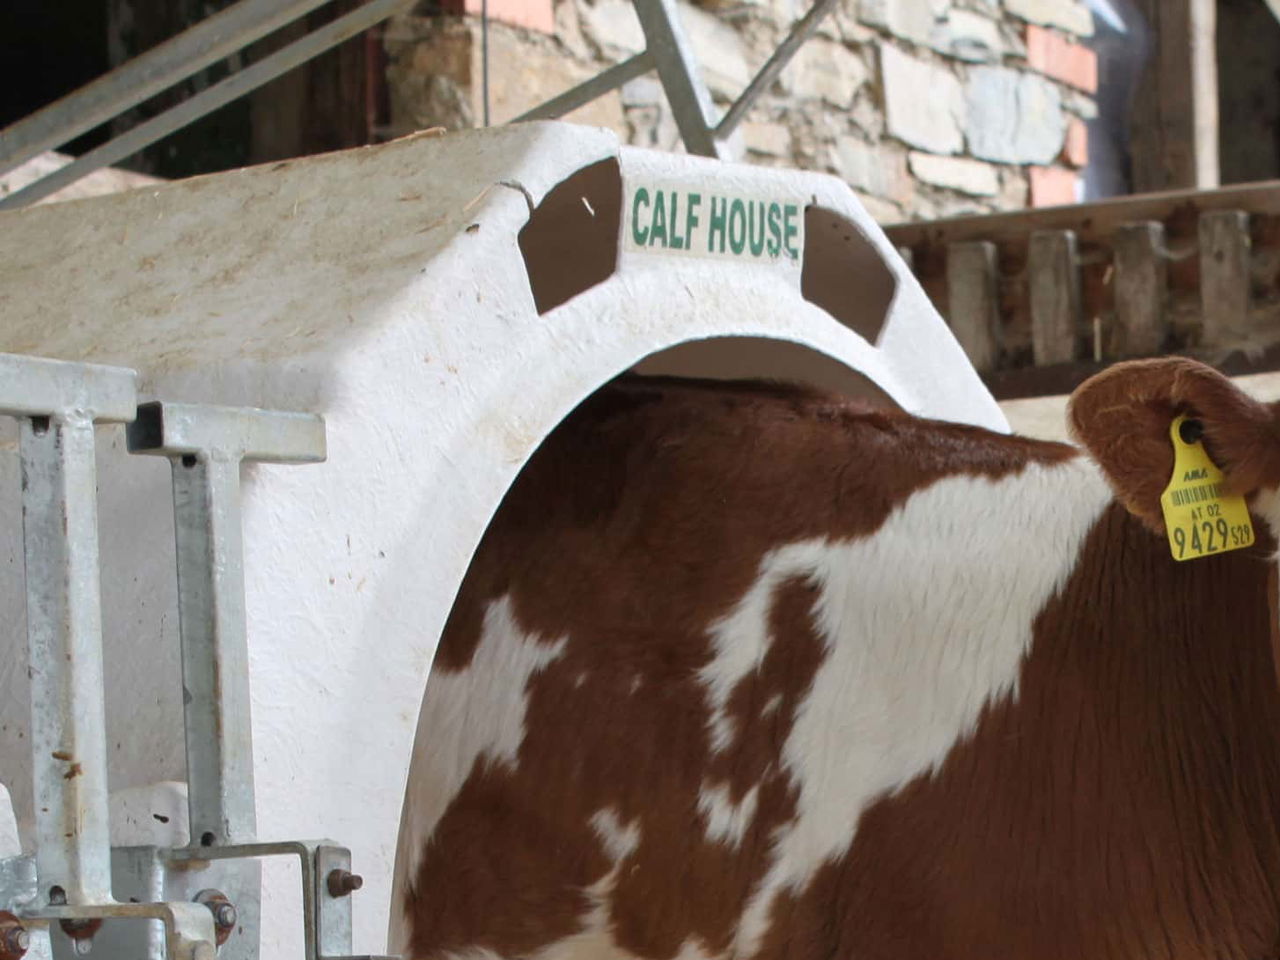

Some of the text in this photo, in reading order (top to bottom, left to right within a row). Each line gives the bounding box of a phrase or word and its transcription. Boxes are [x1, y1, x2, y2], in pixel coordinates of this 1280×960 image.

[632, 187, 799, 260] CALF HOUSE
[1191, 503, 1221, 521] AT 02
[1174, 518, 1250, 558] 9429 529
